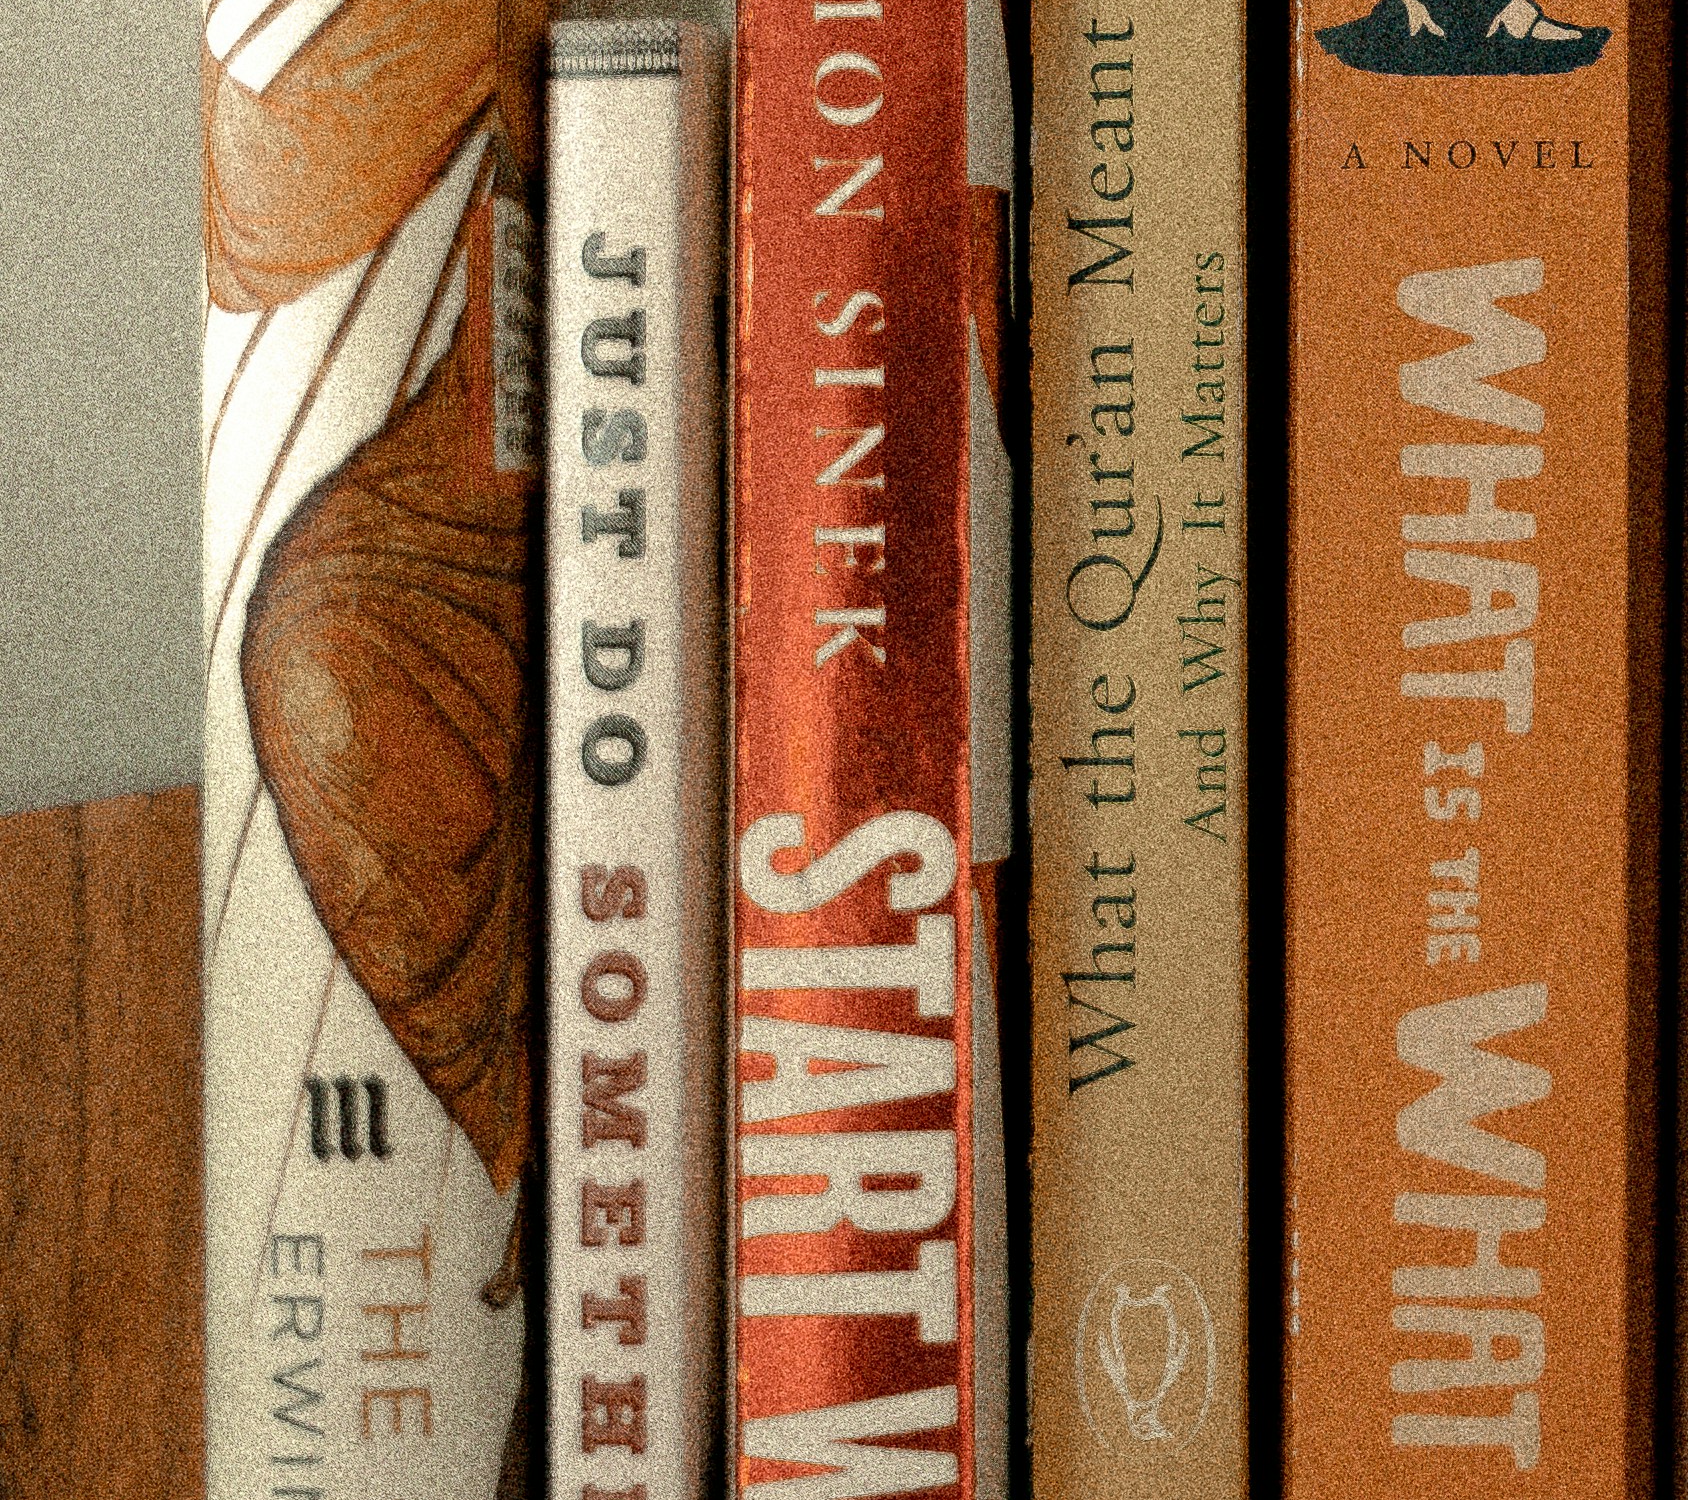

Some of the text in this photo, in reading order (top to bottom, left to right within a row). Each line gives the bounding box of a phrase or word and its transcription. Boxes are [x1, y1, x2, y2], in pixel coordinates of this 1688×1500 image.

[1341, 137, 1595, 171] A NOVEL
[580, 229, 646, 583] JUST
[811, 289, 886, 670] SINEK
[1060, 15, 1164, 1098] What the Qur'an Meant
[1175, 251, 1240, 844] And Why It Matters
[579, 616, 647, 789] DO
[1388, 255, 1553, 1470] WHAT IS THE WHAT
[736, 808, 960, 1345] START
[356, 1230, 437, 1440] THE
